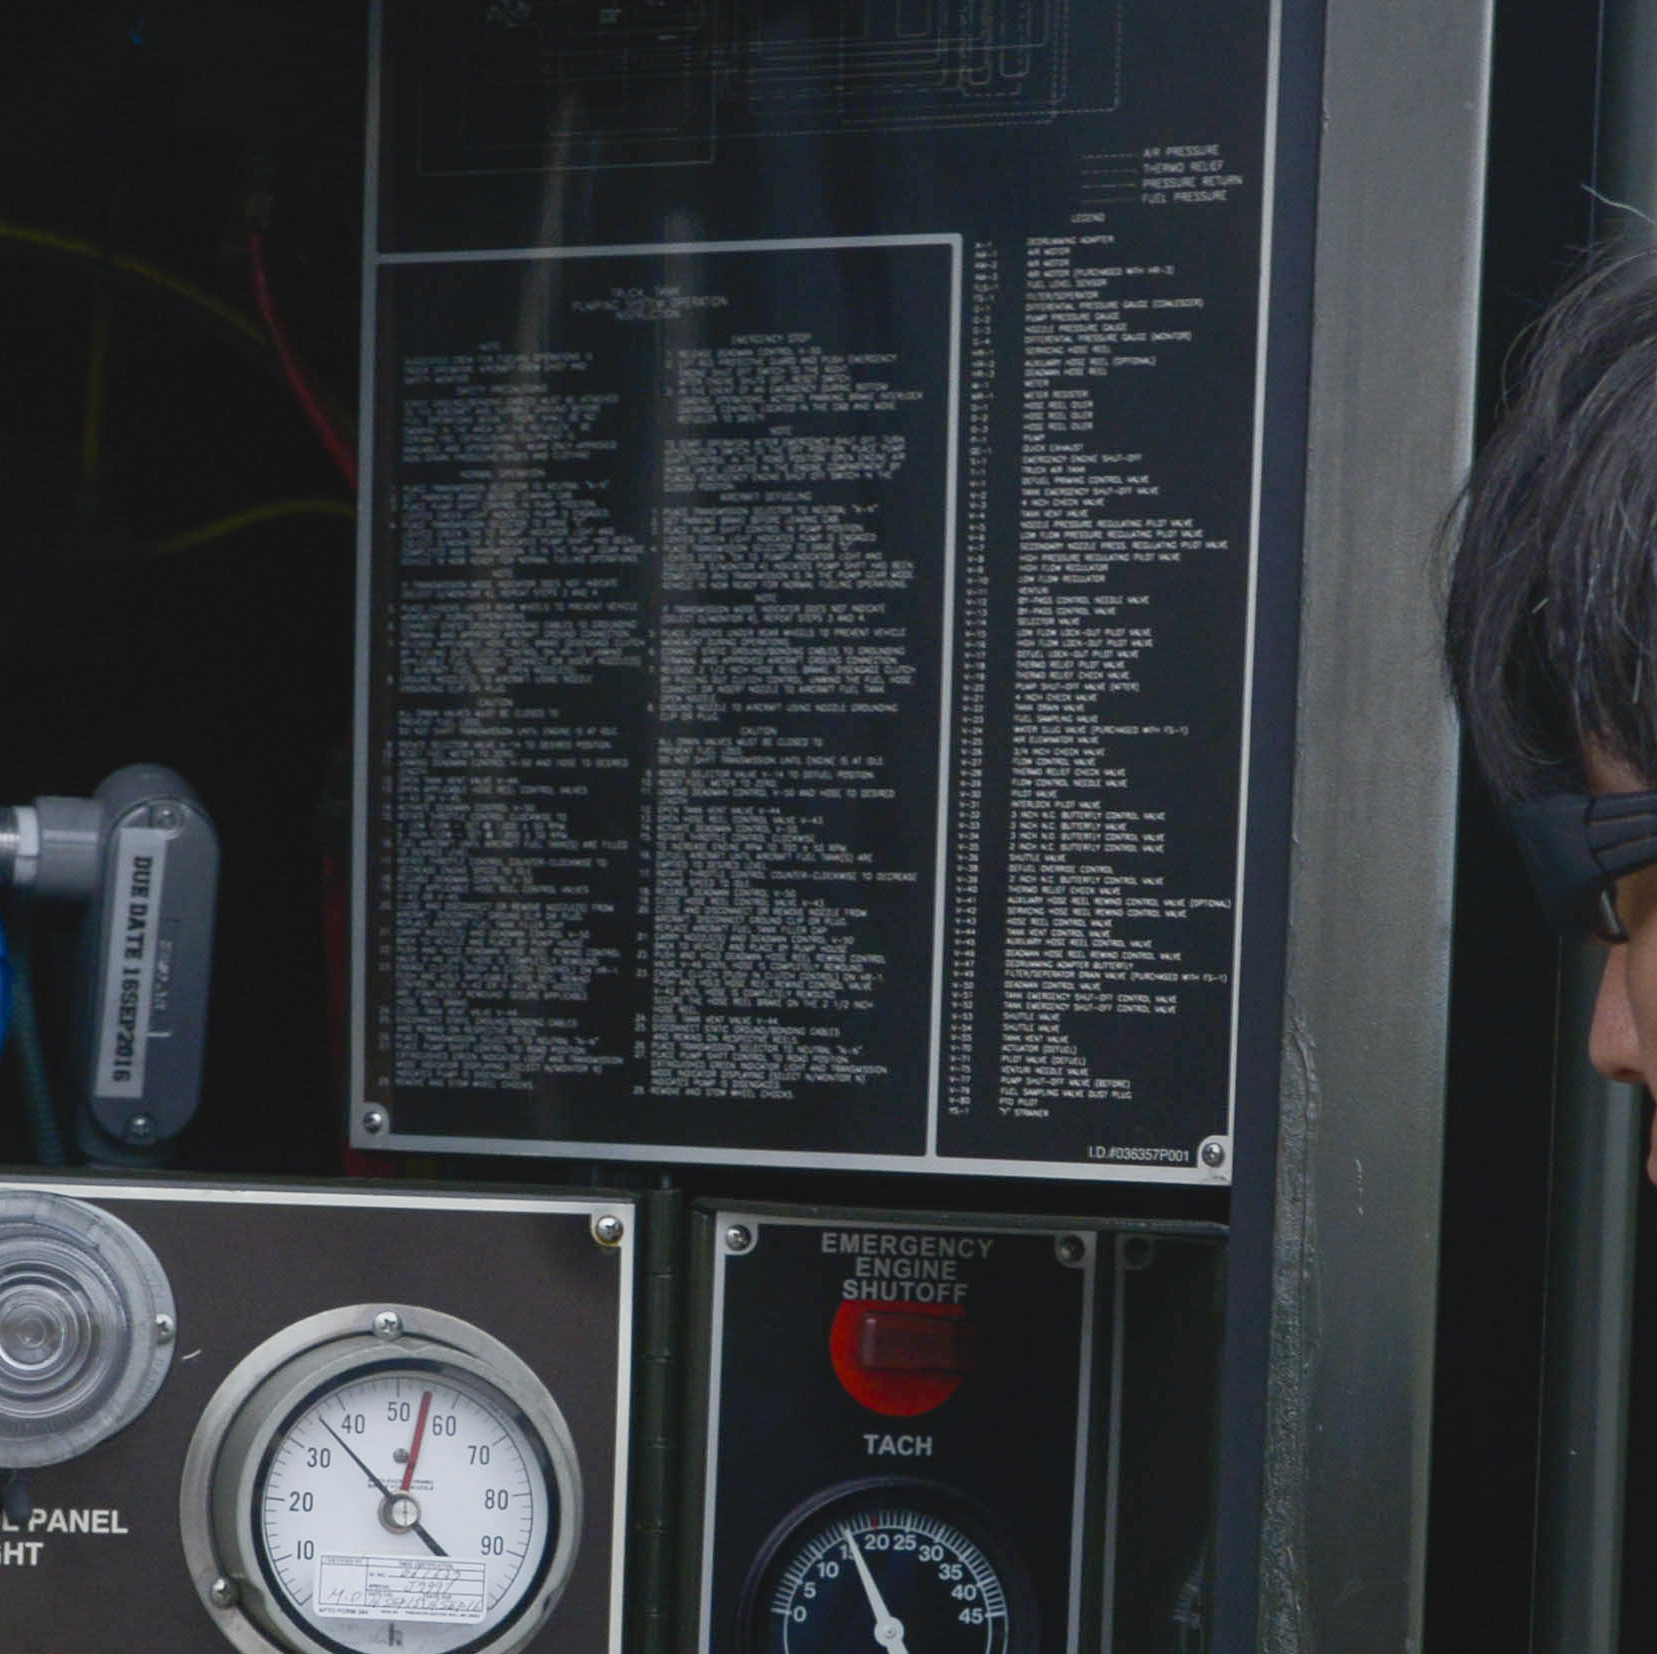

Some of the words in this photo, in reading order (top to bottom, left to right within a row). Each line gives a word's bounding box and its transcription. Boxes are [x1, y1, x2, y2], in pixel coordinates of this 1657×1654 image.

[131, 857, 152, 898] DUE
[124, 903, 148, 959] DATE
[821, 1231, 995, 1260] EMERGENCY
[855, 1256, 958, 1281] ENGINE
[842, 1278, 969, 1304] SHUTOFF
[387, 1401, 411, 1422] 50
[341, 1413, 366, 1435] 40
[432, 1416, 456, 1437] 60
[467, 1445, 490, 1465] 70
[863, 1434, 933, 1457] TACH
[306, 1447, 331, 1468] 30
[289, 1491, 314, 1512] 20
[484, 1490, 509, 1510] 80
[29, 1508, 129, 1534] PANEL
[480, 1536, 504, 1556] 90
[865, 1533, 891, 1551] 20
[893, 1533, 918, 1551] 25
[918, 1544, 944, 1562] 30
[939, 1564, 964, 1582] 35
[951, 1583, 978, 1601] 40
[958, 1607, 985, 1625] 45
